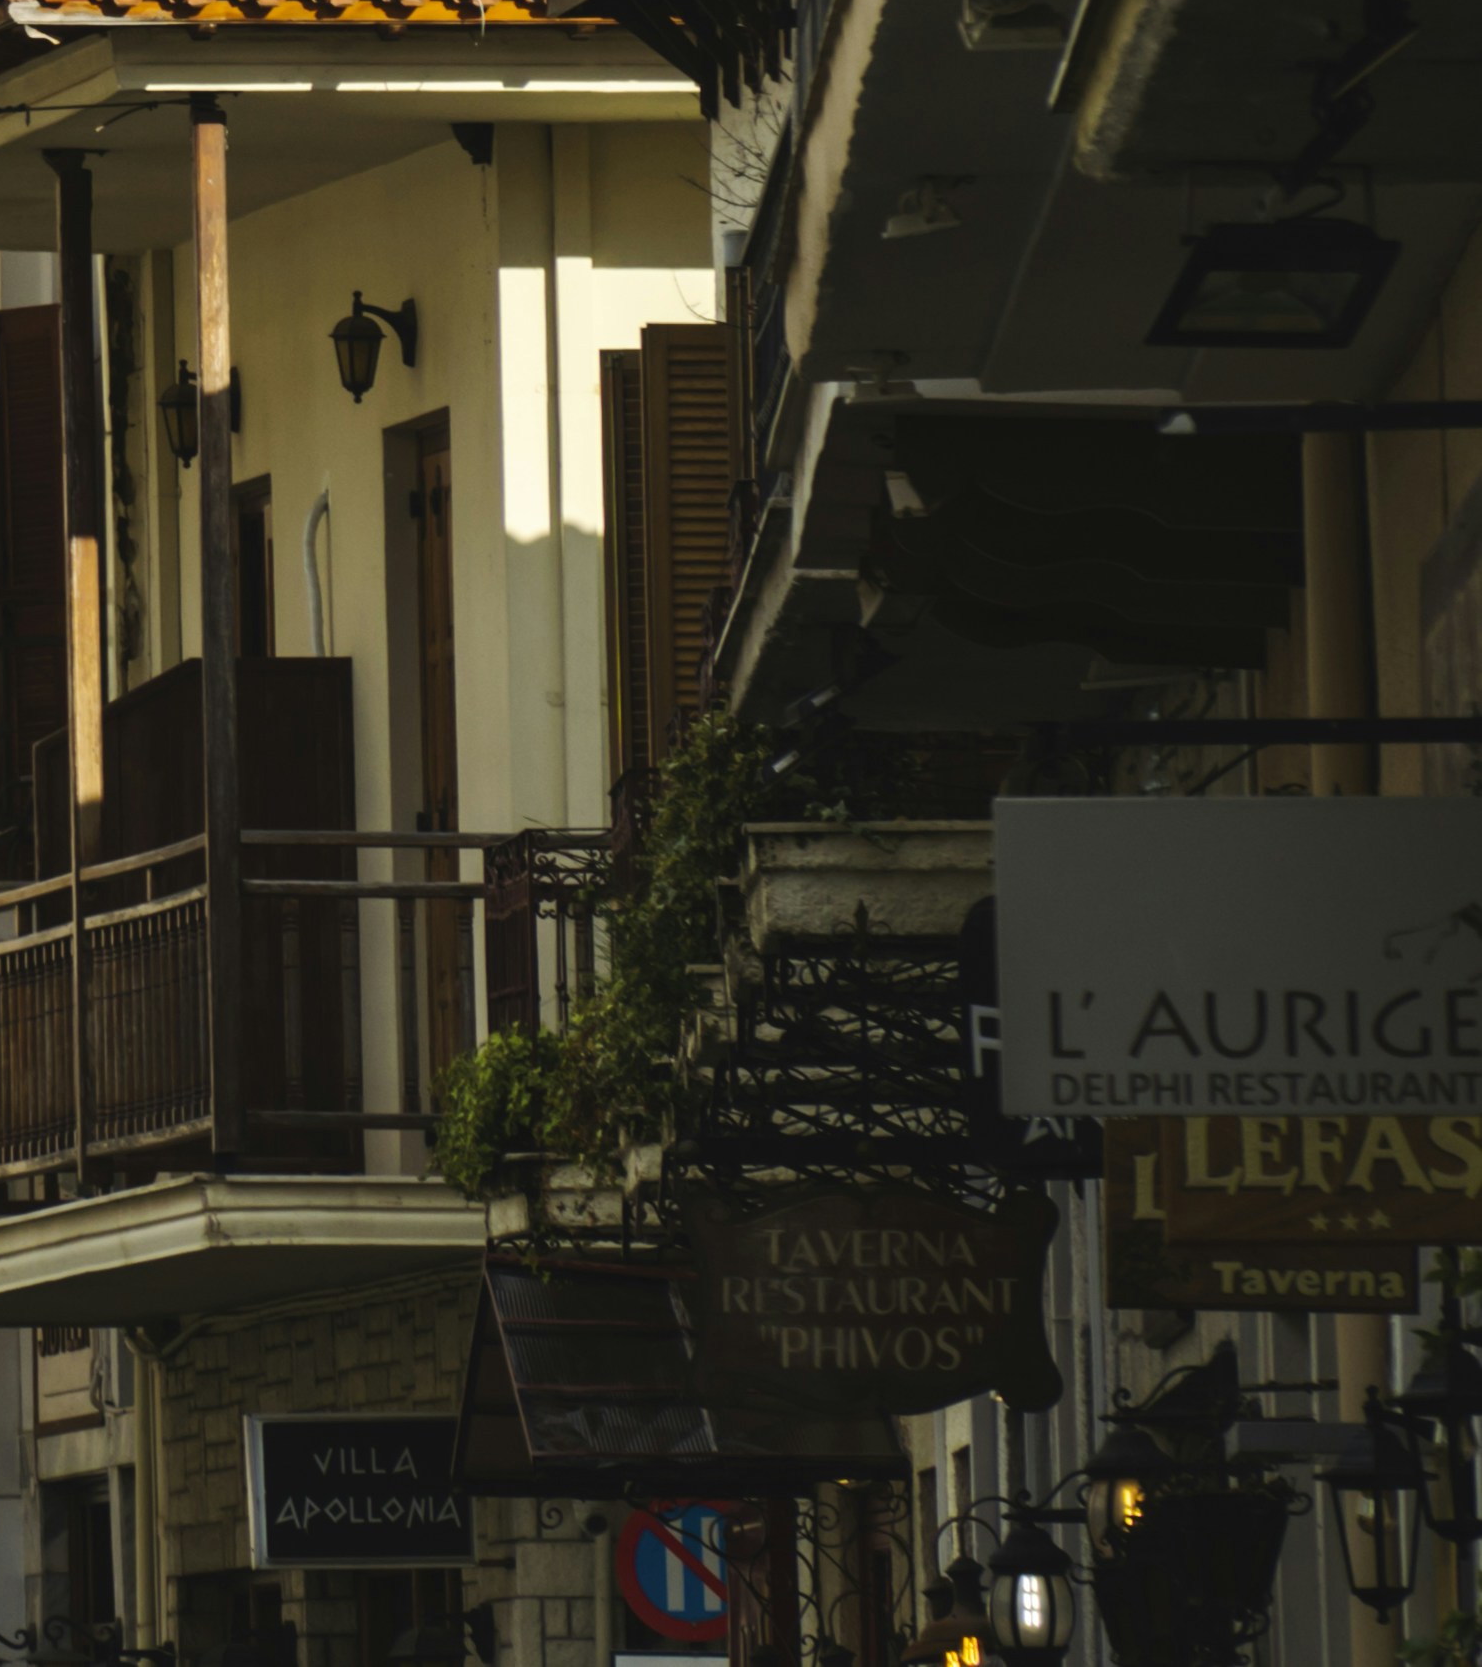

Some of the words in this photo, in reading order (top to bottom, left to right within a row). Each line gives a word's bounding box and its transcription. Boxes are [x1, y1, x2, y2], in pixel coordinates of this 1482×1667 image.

[1052, 1071, 1194, 1106] DELPHI
[1208, 1070, 1482, 1106] RESTAURANT
[1183, 1116, 1482, 1199] LEFAS
[759, 1229, 977, 1272] TAVERNA
[721, 1277, 1020, 1316] RESTAURANT
[1212, 1260, 1405, 1300] Taverna
[760, 1324, 985, 1372] "PHIVOS"
[313, 1446, 419, 1480] VILLA
[274, 1495, 462, 1533] APOLLONIA
